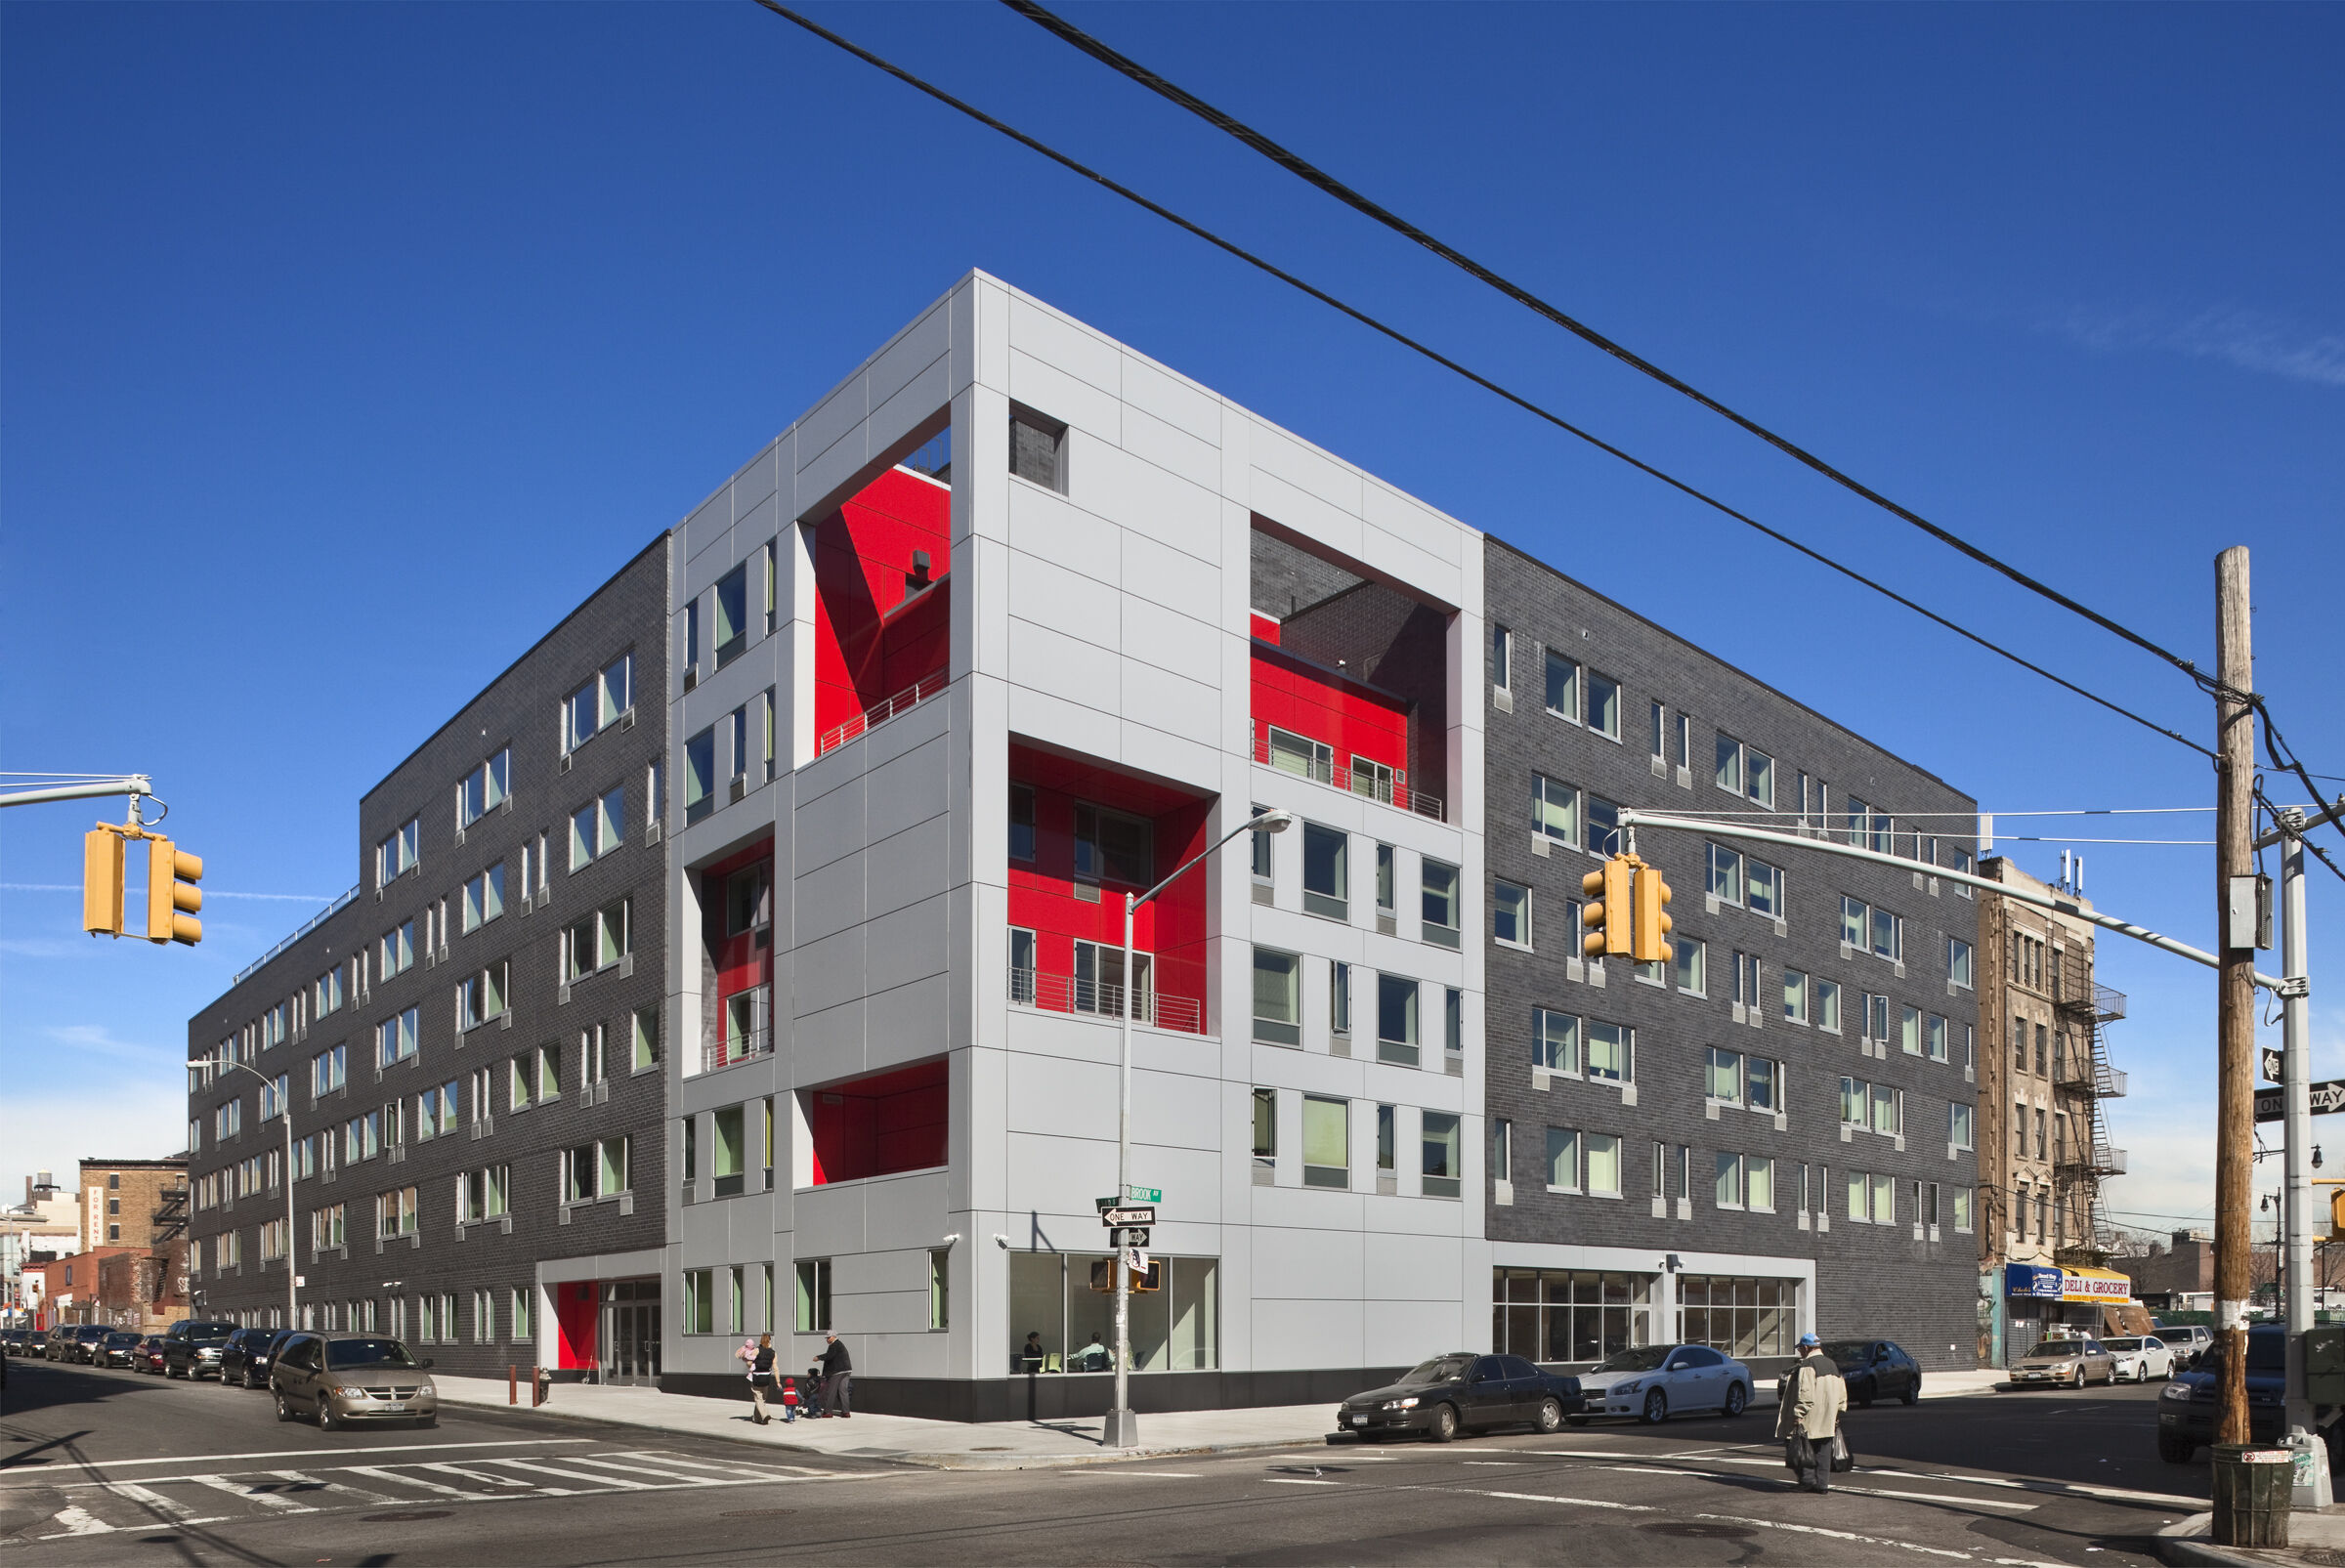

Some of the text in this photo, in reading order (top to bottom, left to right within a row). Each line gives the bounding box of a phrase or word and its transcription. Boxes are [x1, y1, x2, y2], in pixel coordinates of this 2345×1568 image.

[2261, 1089, 2344, 1112] ON WAY
[1130, 1187, 1151, 1201] BROOK
[1109, 1211, 1148, 1221] ONE WAY
[1130, 1232, 1144, 1242] WAY
[2065, 1279, 2082, 1292] DELI
[2084, 1281, 2090, 1293] &
[2092, 1281, 2129, 1294] GROCERY
